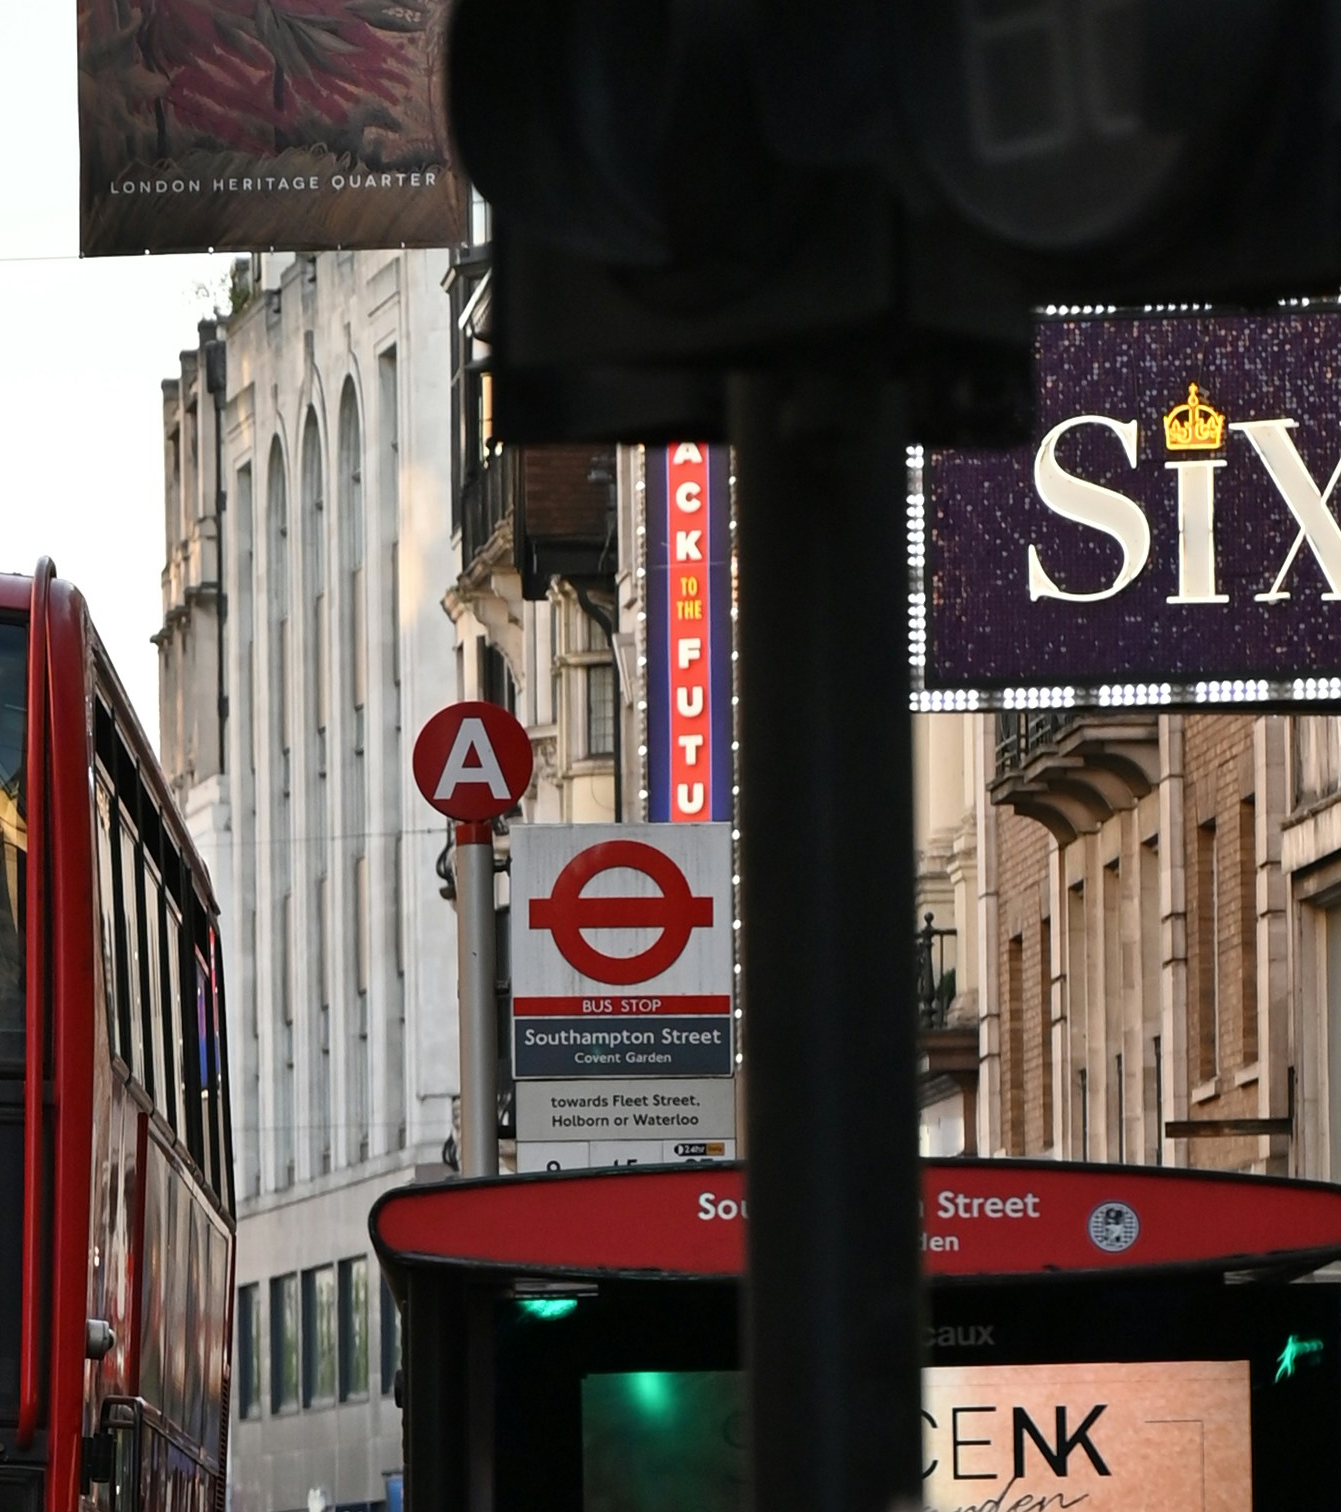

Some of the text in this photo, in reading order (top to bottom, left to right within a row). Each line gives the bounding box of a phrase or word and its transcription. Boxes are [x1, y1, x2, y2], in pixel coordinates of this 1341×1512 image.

[110, 172, 438, 195] LONDON HERITAGE QUARTER
[1028, 415, 1341, 604] SIX
[673, 442, 704, 814] ACK TO THE FUTU
[433, 719, 512, 800] A
[582, 999, 661, 1013] BUS STOP
[524, 1028, 721, 1048] Southampton Street
[574, 1051, 671, 1064] Covent Garden
[551, 1095, 608, 1108] towards
[613, 1095, 648, 1107] Fleet
[552, 1114, 699, 1127] Holborn or Waterloo
[937, 1191, 1041, 1218] Street
